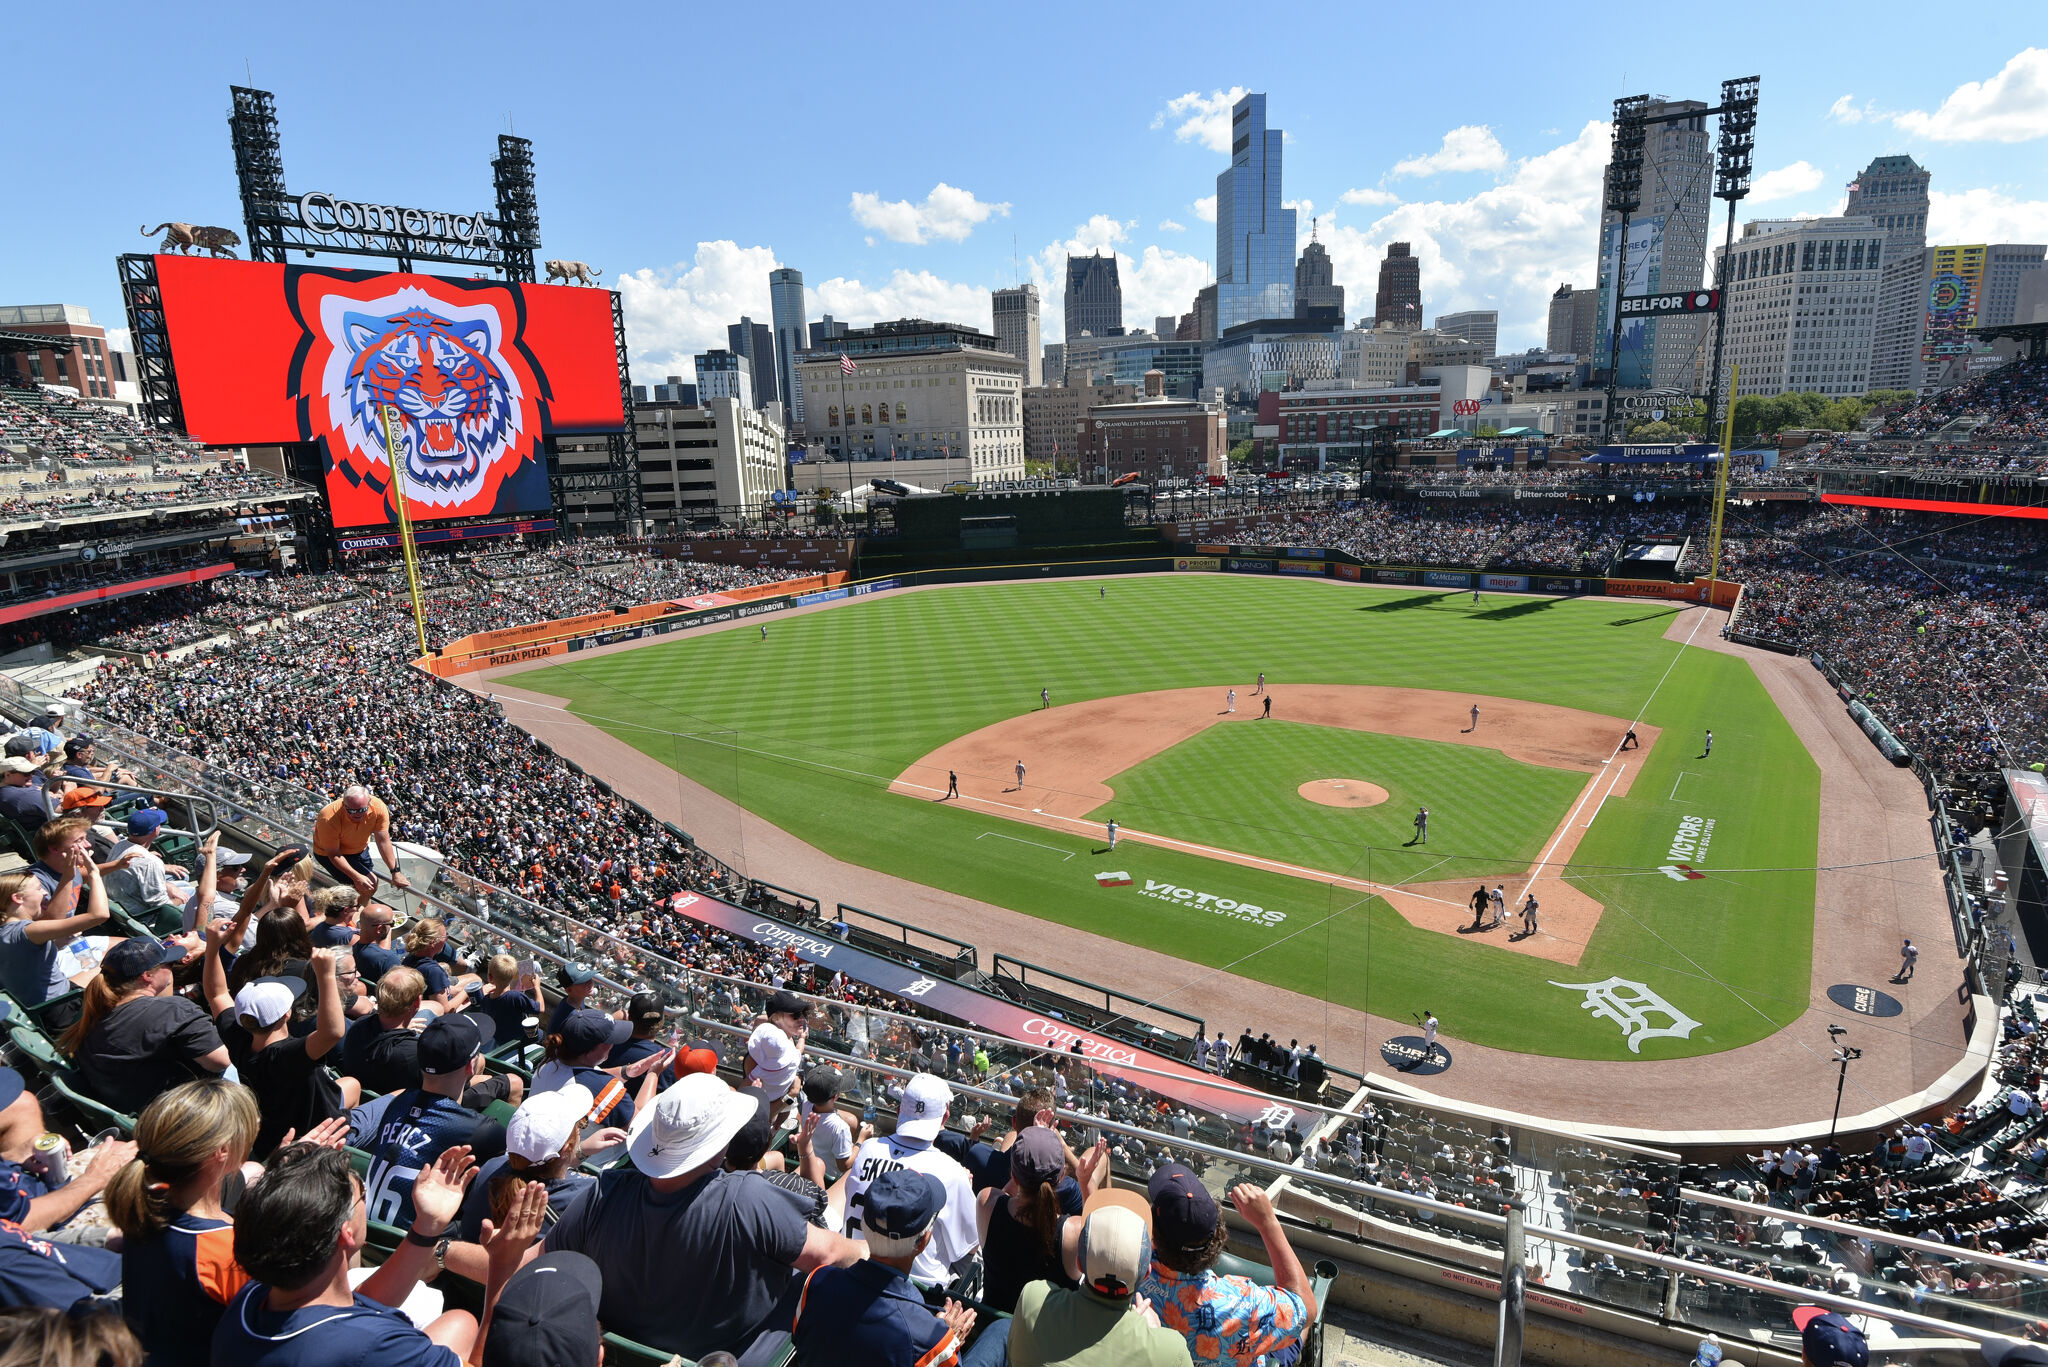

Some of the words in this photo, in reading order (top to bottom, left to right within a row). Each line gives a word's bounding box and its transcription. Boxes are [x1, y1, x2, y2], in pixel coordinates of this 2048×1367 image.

[363, 235, 452, 256] PARK
[1614, 239, 1648, 253] CREC
[1620, 296, 1683, 312] BELFOR
[1455, 400, 1479, 415] AAA
[1715, 380, 1730, 424] Rocket
[390, 421, 410, 474] Rocket
[1479, 447, 1494, 458] Lite
[1623, 447, 1640, 457] Lite
[982, 479, 1073, 491] CHEVROLET
[1158, 476, 1189, 488] meijer
[965, 492, 1061, 500] FOUNTAIN
[1522, 490, 1568, 498] litter-robot
[97, 541, 134, 553] Gallagher
[1439, 574, 1466, 583] McLaren
[1490, 577, 1518, 588] meijer
[856, 585, 872, 595] DTE
[1607, 583, 1635, 592] PIZZA!
[1636, 584, 1667, 594] PIZZA!
[747, 602, 784, 615] GAMEABOVE
[676, 619, 700, 629] BETMGM
[707, 613, 731, 622] BETMGM
[490, 652, 520, 666] PIZZA!
[522, 647, 551, 660] PIZZA!
[1666, 815, 1704, 861] VICTORS
[1700, 818, 1716, 847] SOLUTIONS
[1695, 846, 1707, 863] HOME
[1145, 879, 1287, 922] VICTORS
[1137, 889, 1181, 903] HOME
[1183, 901, 1275, 927] SOLUTIONS
[1854, 990, 1870, 1012] CURE
[380, 1117, 432, 1155] PÉREZ
[1453, 1273, 1466, 1282] NOT
[1467, 1277, 1485, 1287] LEAN,
[1486, 1282, 1496, 1290] SIT
[1540, 1297, 1568, 1309] AGAINST
[1569, 1305, 1584, 1314] RAIL
